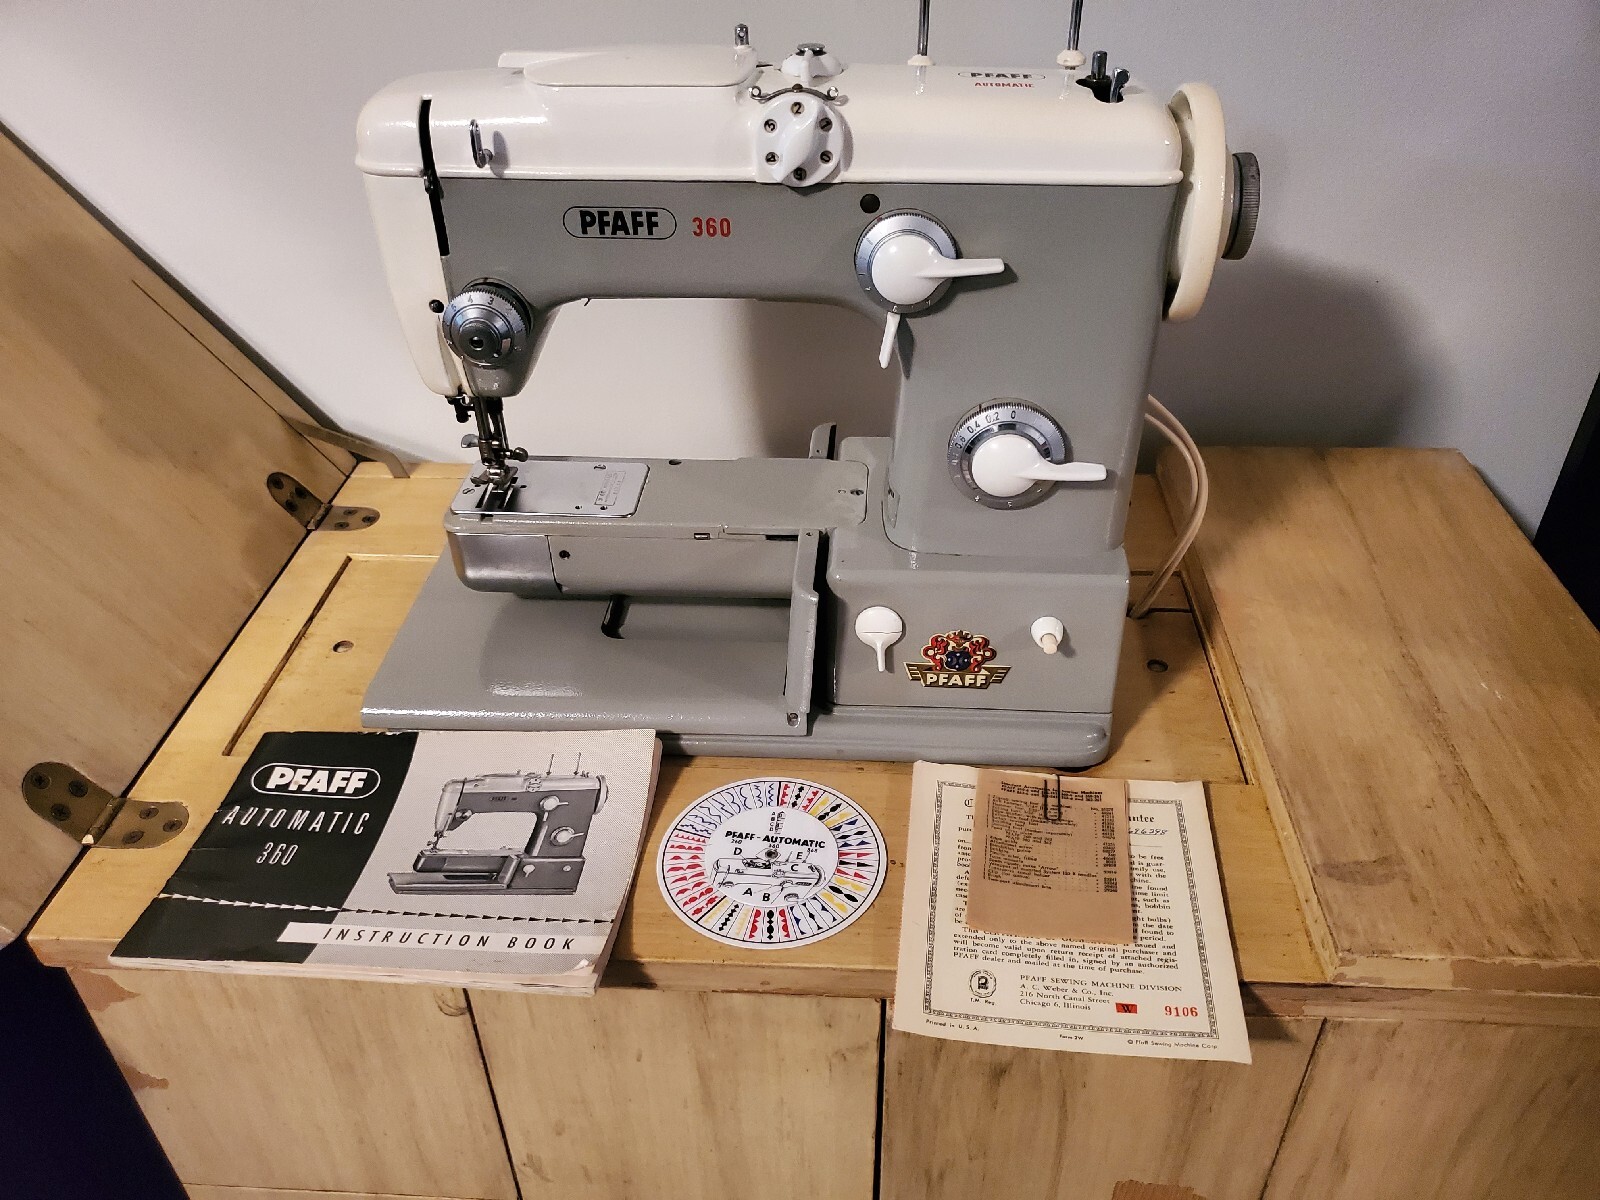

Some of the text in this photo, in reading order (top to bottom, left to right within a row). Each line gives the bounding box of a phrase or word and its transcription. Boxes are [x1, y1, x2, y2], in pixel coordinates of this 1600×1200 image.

[793, 101, 802, 115] 2
[579, 209, 731, 238] PFAFF 360
[966, 420, 981, 434] 0.4
[926, 673, 986, 687] PFAFF
[265, 766, 368, 794] PFAFF
[222, 805, 370, 835] AUTOMATIC
[725, 830, 756, 841] PFAFF
[762, 834, 826, 849] AUTOMATIC
[256, 842, 299, 866] 360
[733, 847, 743, 856] D
[796, 851, 803, 860] E
[790, 864, 799, 872] C
[742, 887, 753, 897] A
[762, 893, 771, 902] B
[323, 928, 575, 950] INSTRUCTION BOOK
[953, 933, 986, 941] extended
[1036, 940, 1058, 948] above
[1088, 945, 1119, 953] original
[1122, 948, 1158, 956] purchaser
[972, 941, 1000, 949] become
[1026, 947, 1046, 955] upon
[1078, 951, 1104, 959] receipt
[953, 951, 980, 960] PFAFF
[981, 955, 1005, 963] dealer
[1024, 959, 1050, 967] mailed
[1109, 967, 1145, 975] purchase.
[1001, 951, 1042, 960] completely
[1082, 958, 1107, 967] signed
[1137, 962, 1179, 970] authorized
[1020, 974, 1182, 992] PFAFF SEWING MACHINE DIVISION
[1043, 985, 1069, 994] Weber
[1020, 998, 1051, 1008] Chicago
[1063, 1001, 1092, 1011] Illinois
[1036, 992, 1060, 1000] North
[1063, 994, 1085, 1003] Canal
[1087, 996, 1111, 1004] Street
[1121, 1003, 1132, 1014] W
[1164, 1005, 1199, 1018] 9106
[925, 1018, 947, 1027] Printed
[1151, 1040, 1172, 1048] Sewing
